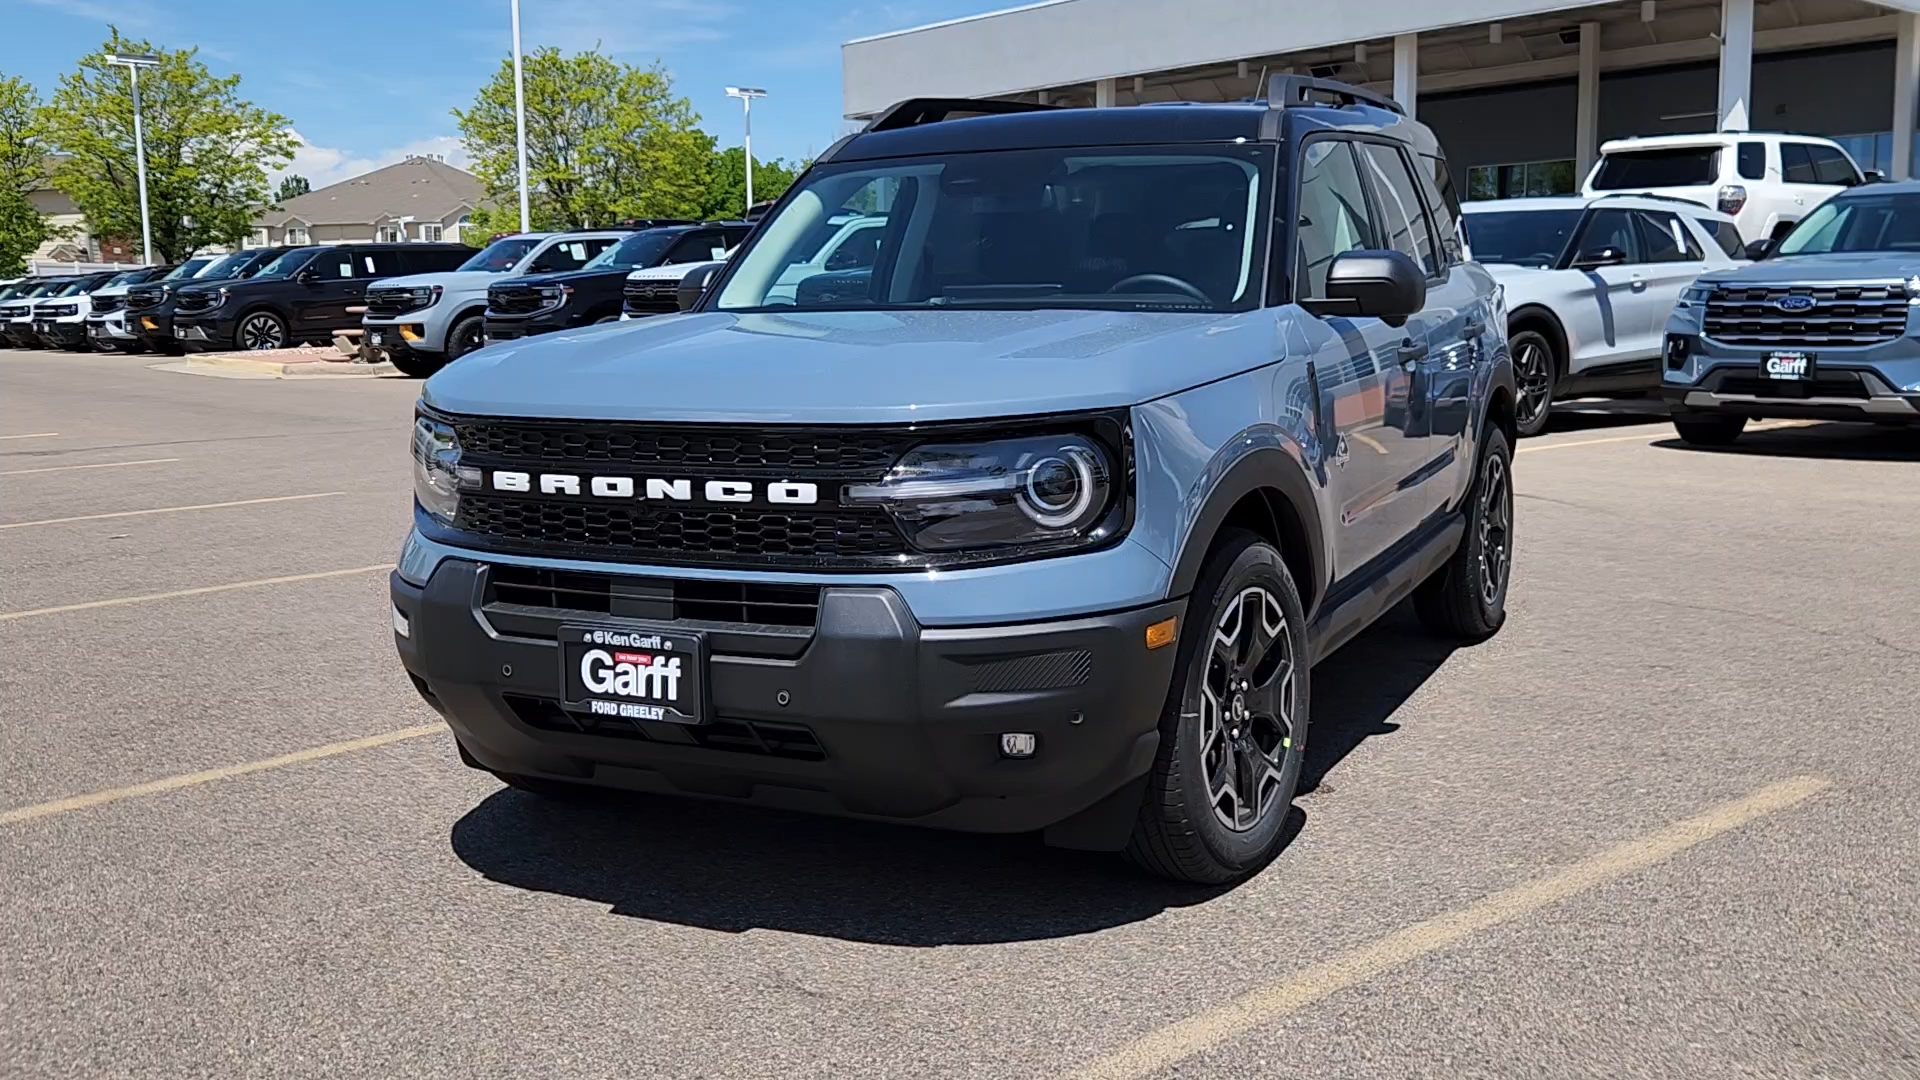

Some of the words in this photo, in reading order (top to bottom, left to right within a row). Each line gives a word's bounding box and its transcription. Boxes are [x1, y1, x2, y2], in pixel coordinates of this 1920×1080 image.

[1766, 357, 1808, 374] Garff
[492, 470, 818, 504] BRONCO
[580, 648, 682, 701] Garff
[591, 701, 617, 715] FORD
[619, 703, 665, 721] GREELEY
